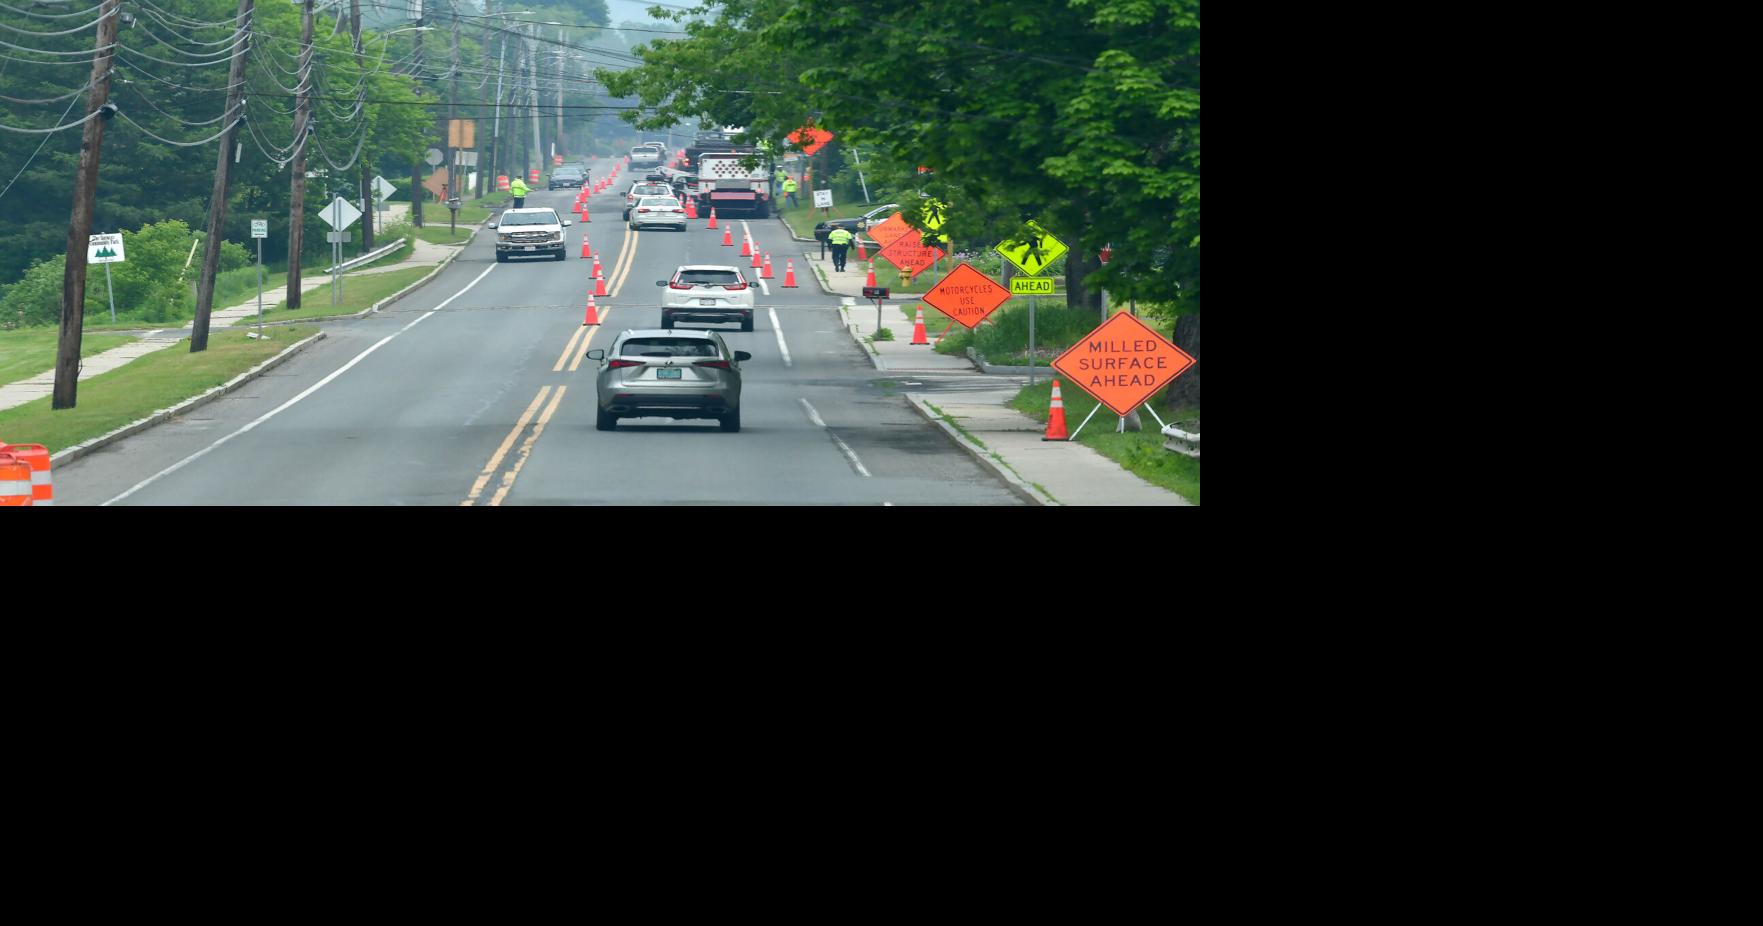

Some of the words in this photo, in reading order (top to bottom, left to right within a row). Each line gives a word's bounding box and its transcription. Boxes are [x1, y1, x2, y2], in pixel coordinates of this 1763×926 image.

[940, 285, 993, 296] MOTORCYCLES
[1014, 281, 1050, 291] AHEAD
[959, 297, 975, 305] USE
[952, 307, 985, 316] CAUTION
[1089, 340, 1157, 353] MILLED
[1079, 356, 1167, 370] SURFACE
[1090, 374, 1155, 387] AHEAD
